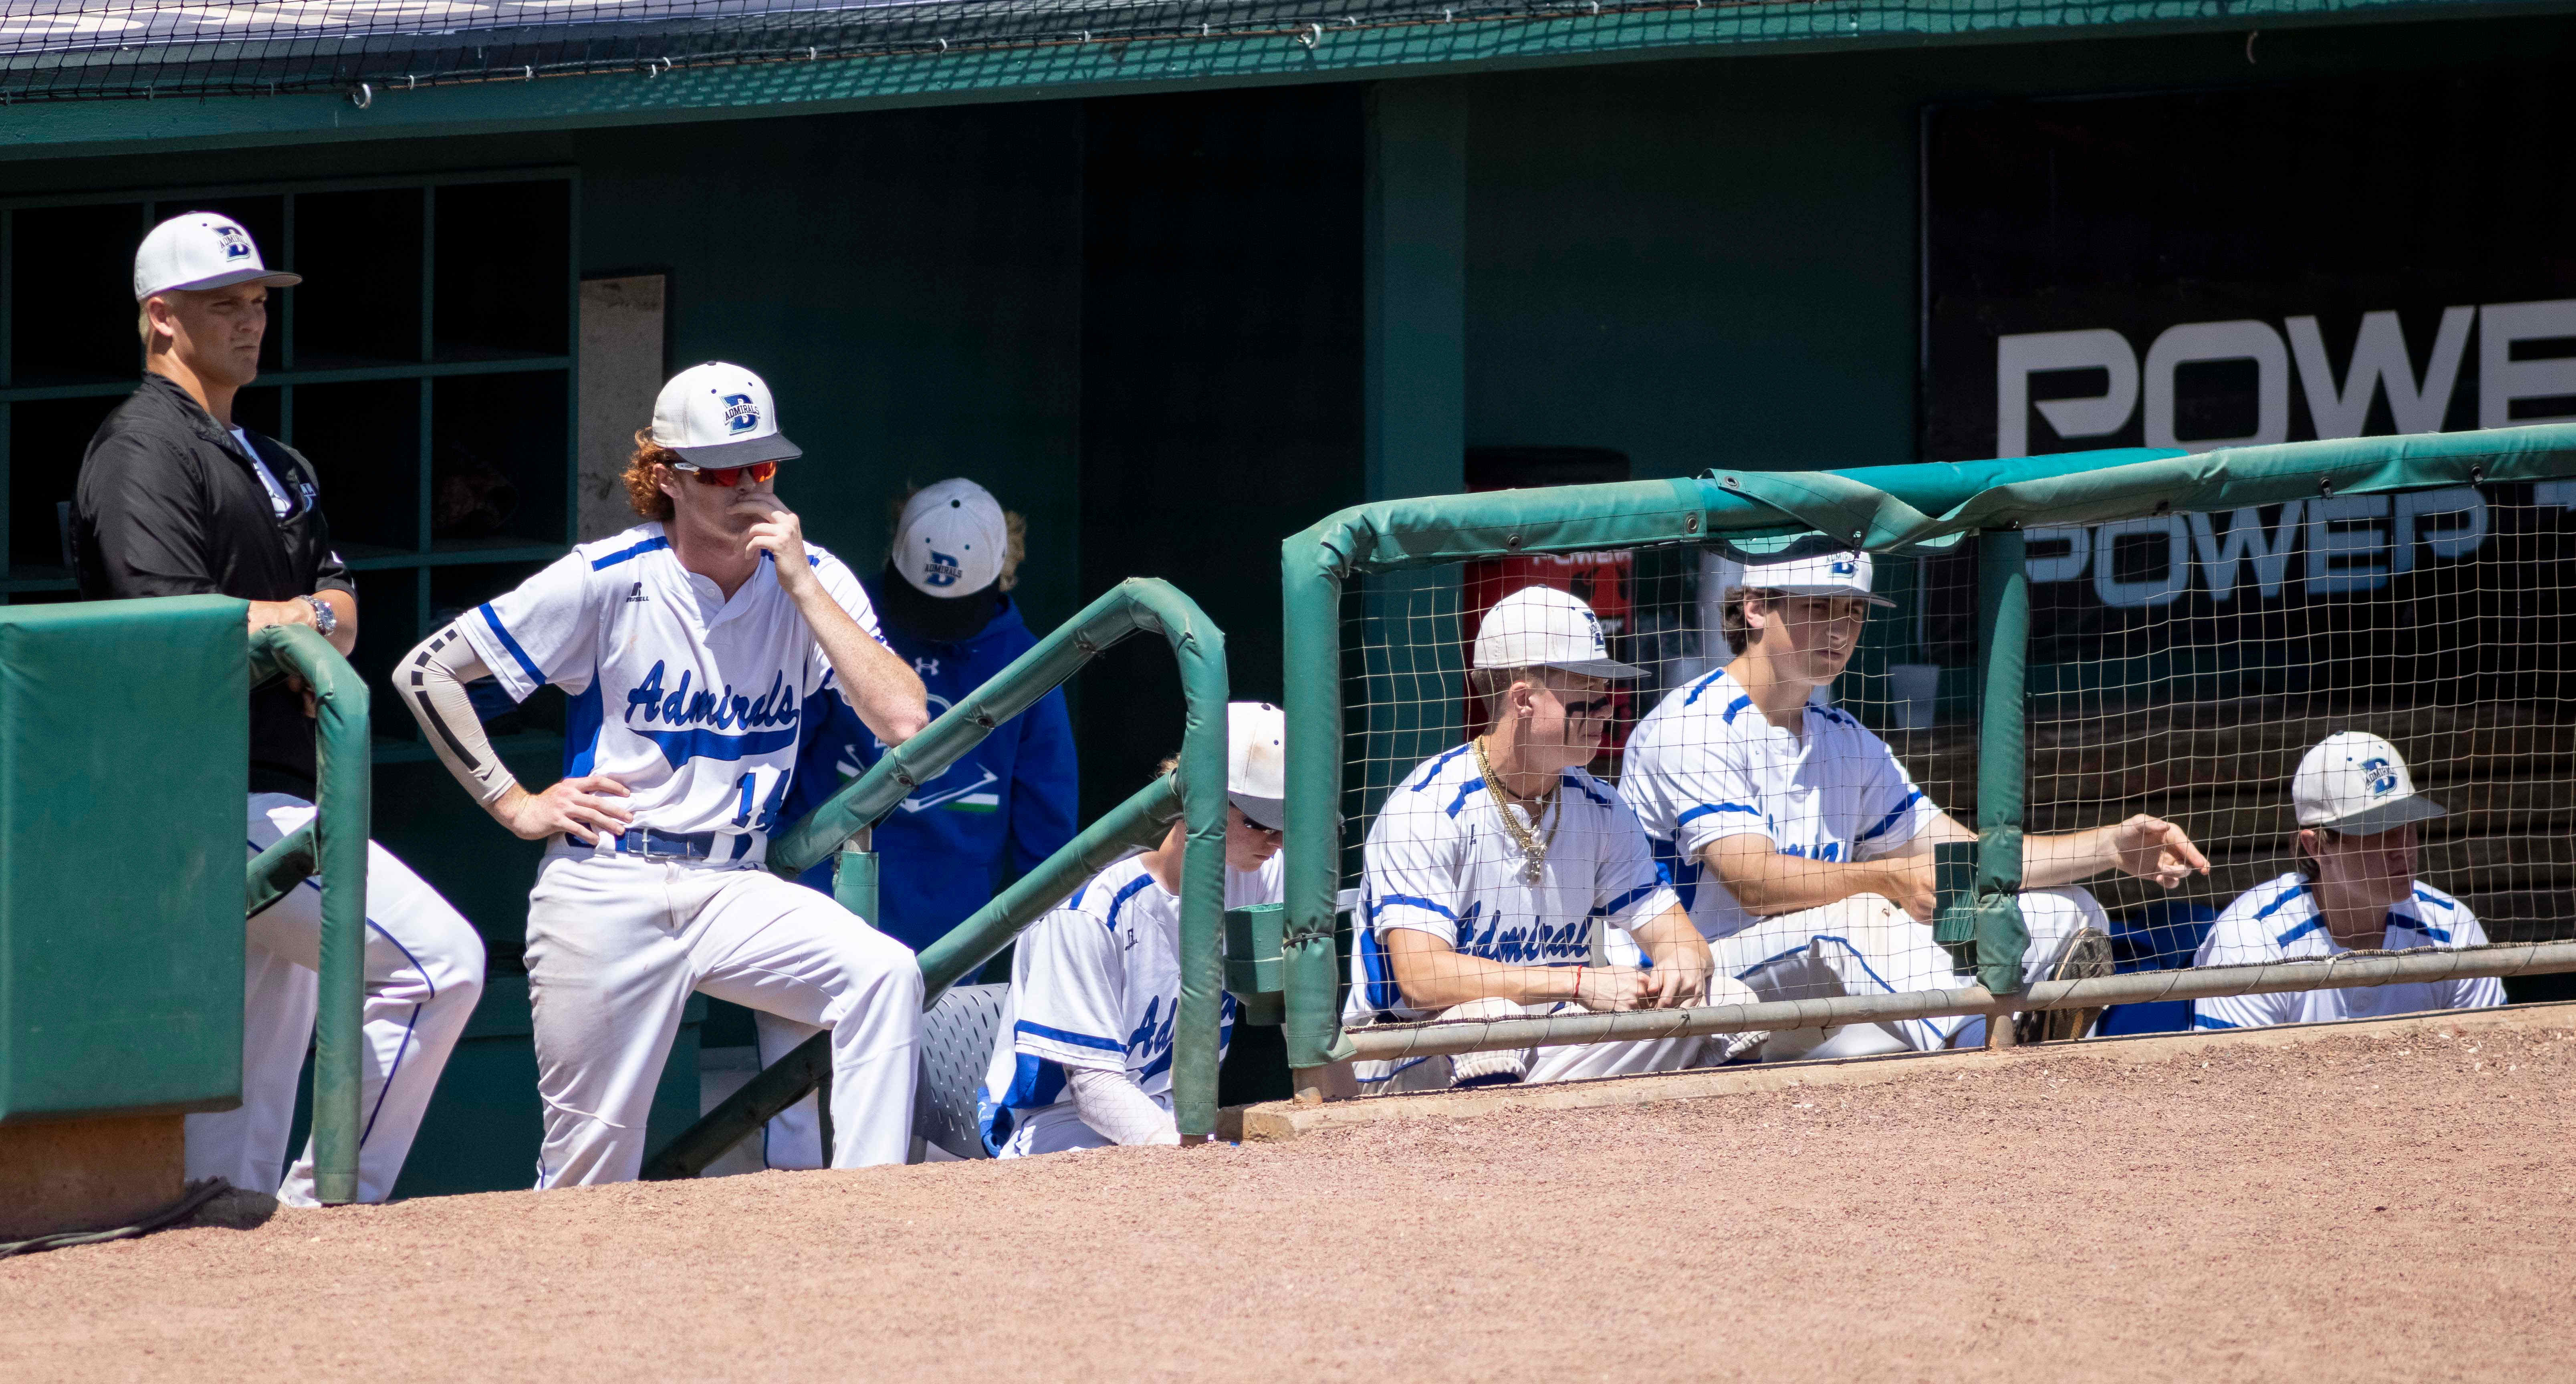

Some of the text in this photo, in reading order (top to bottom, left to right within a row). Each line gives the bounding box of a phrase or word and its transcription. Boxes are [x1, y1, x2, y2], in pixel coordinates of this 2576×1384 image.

[725, 405, 760, 421] ADMIRALS
[924, 564, 962, 578] ADMIRALS
[624, 659, 800, 730] Admirals
[1455, 900, 1593, 962] Admiral
